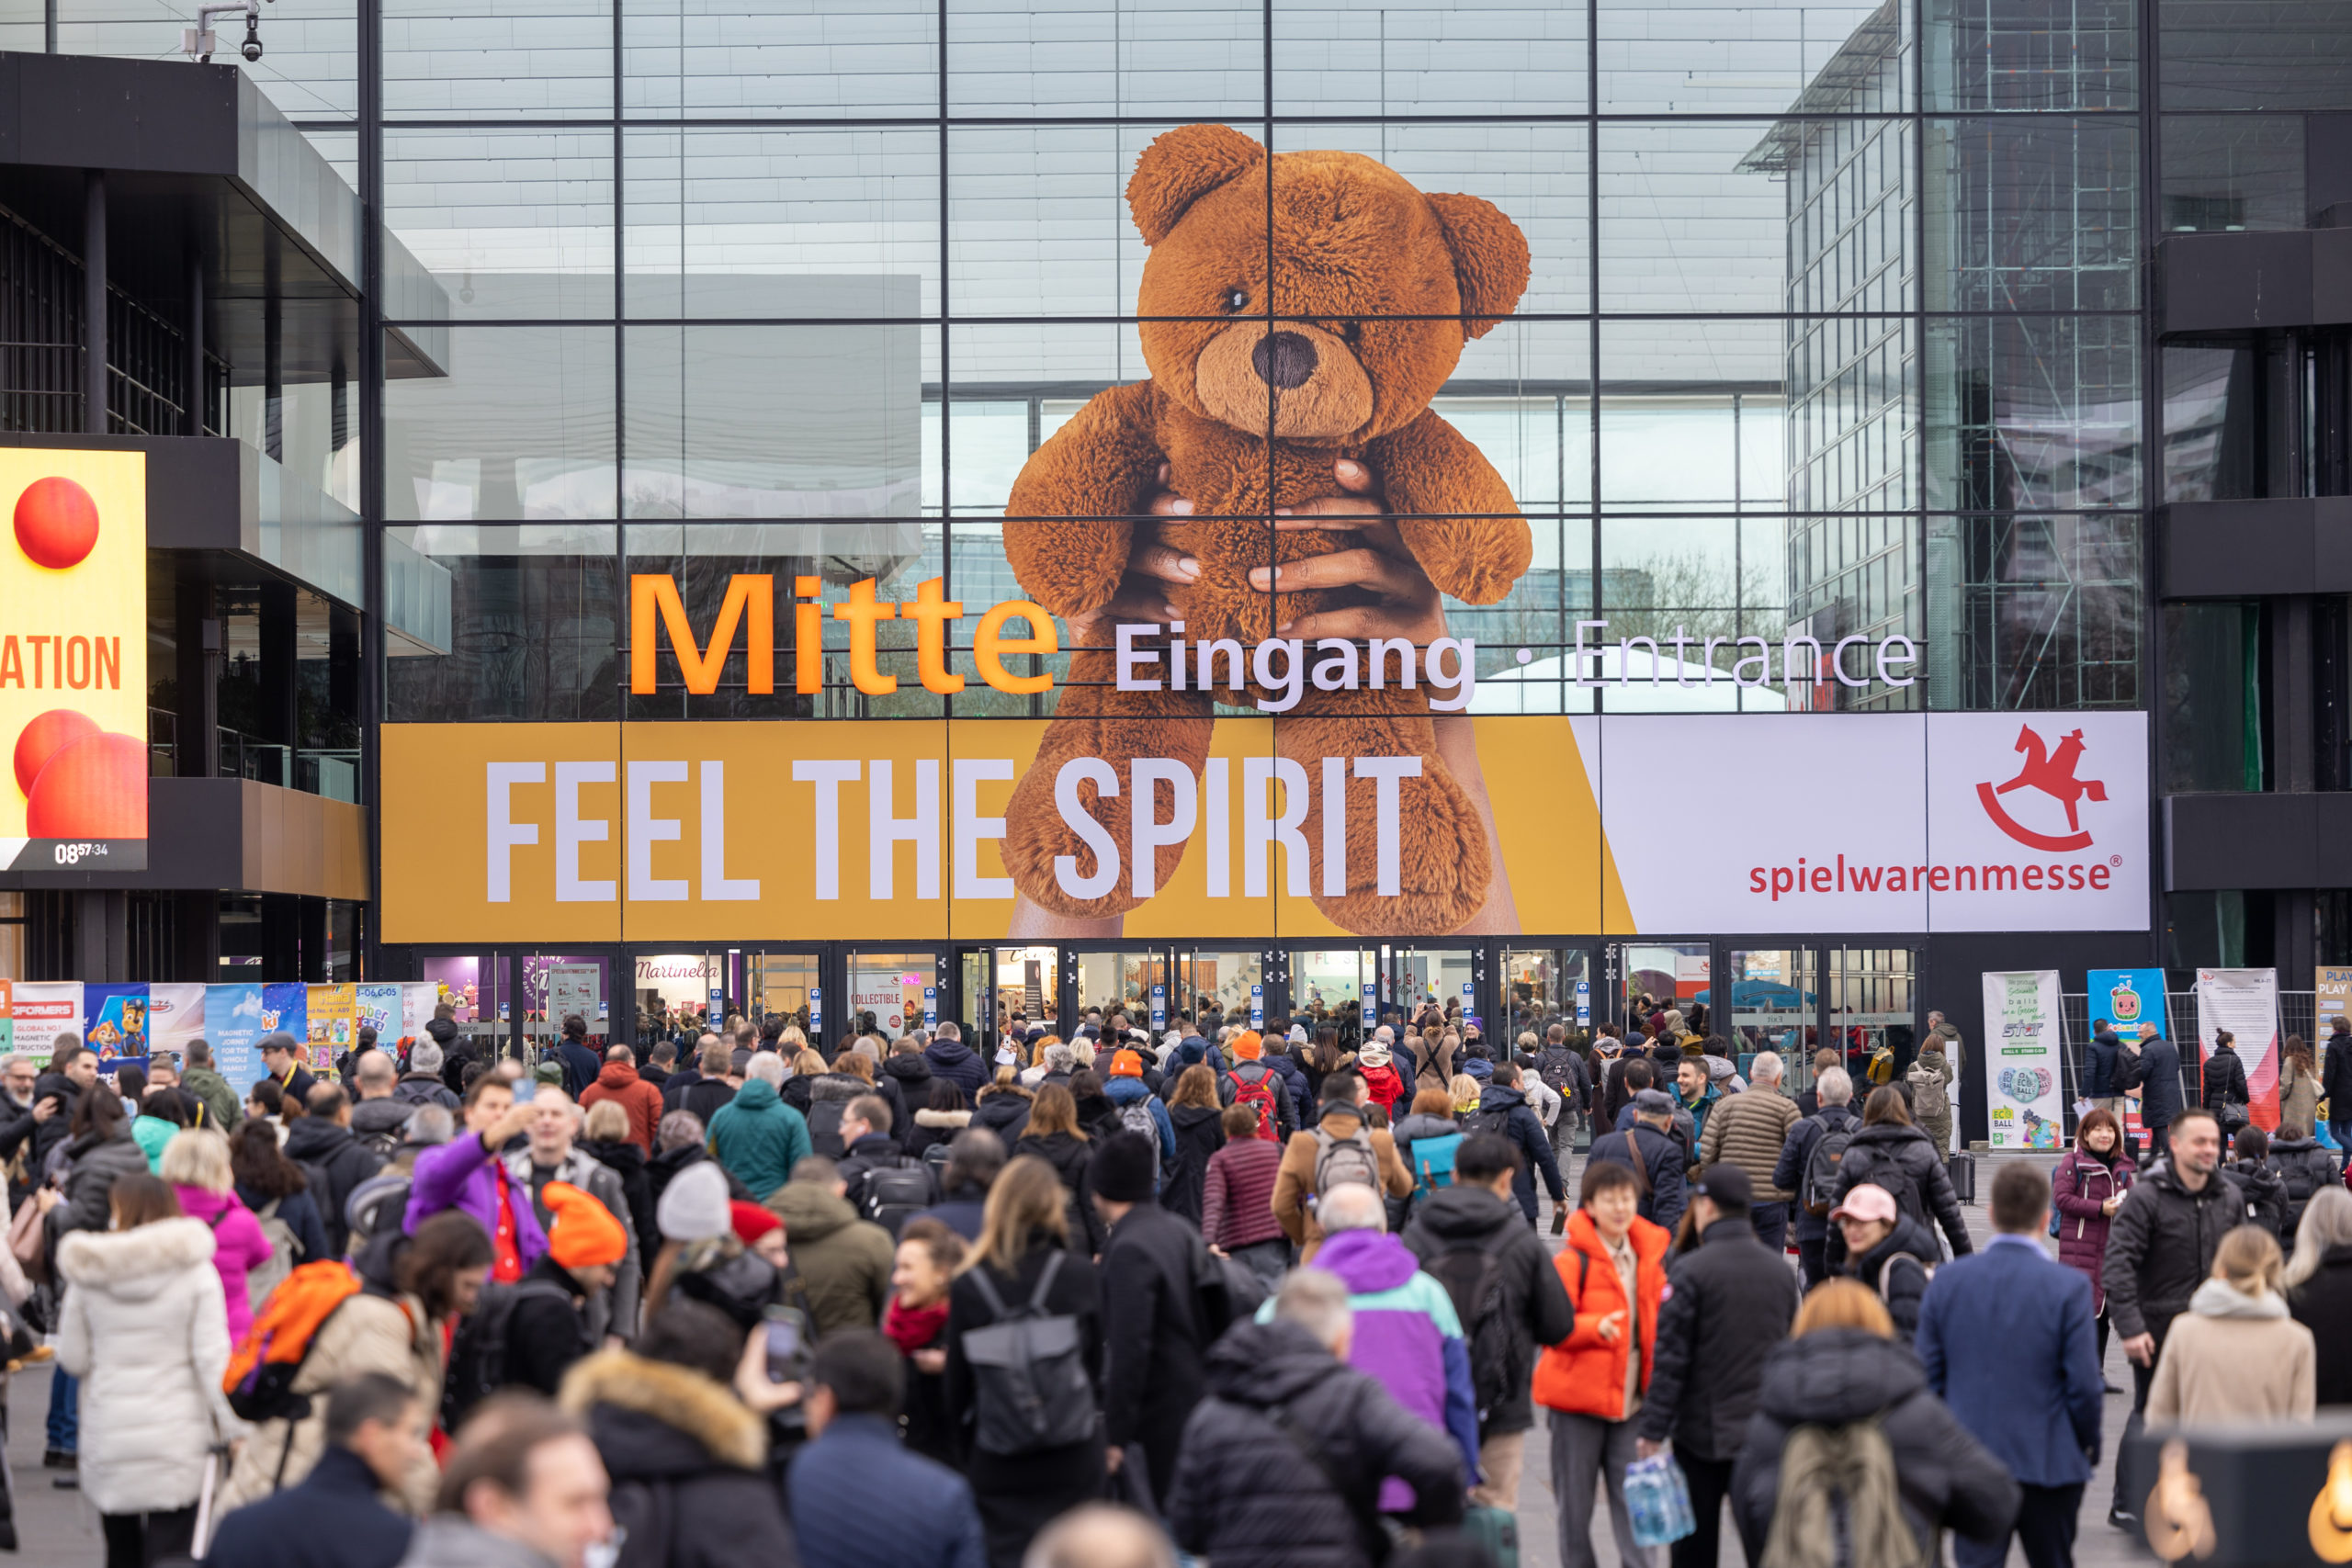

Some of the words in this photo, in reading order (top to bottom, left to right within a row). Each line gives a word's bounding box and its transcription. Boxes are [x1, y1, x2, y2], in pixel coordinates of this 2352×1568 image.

[630, 573, 1058, 695] Mitte
[0, 636, 121, 690] ATION
[1115, 620, 1476, 713] Eingang
[1576, 620, 1917, 689] Entrance
[487, 761, 760, 902] FEEL
[792, 759, 1014, 899] THE
[1054, 756, 1422, 900] SPIRIT
[635, 961, 719, 978] Martinela
[320, 992, 350, 1003] Hama
[2318, 984, 2347, 995] PLAY
[218, 1029, 254, 1037] MAGNETIC
[1993, 1110, 2012, 1119] ECO
